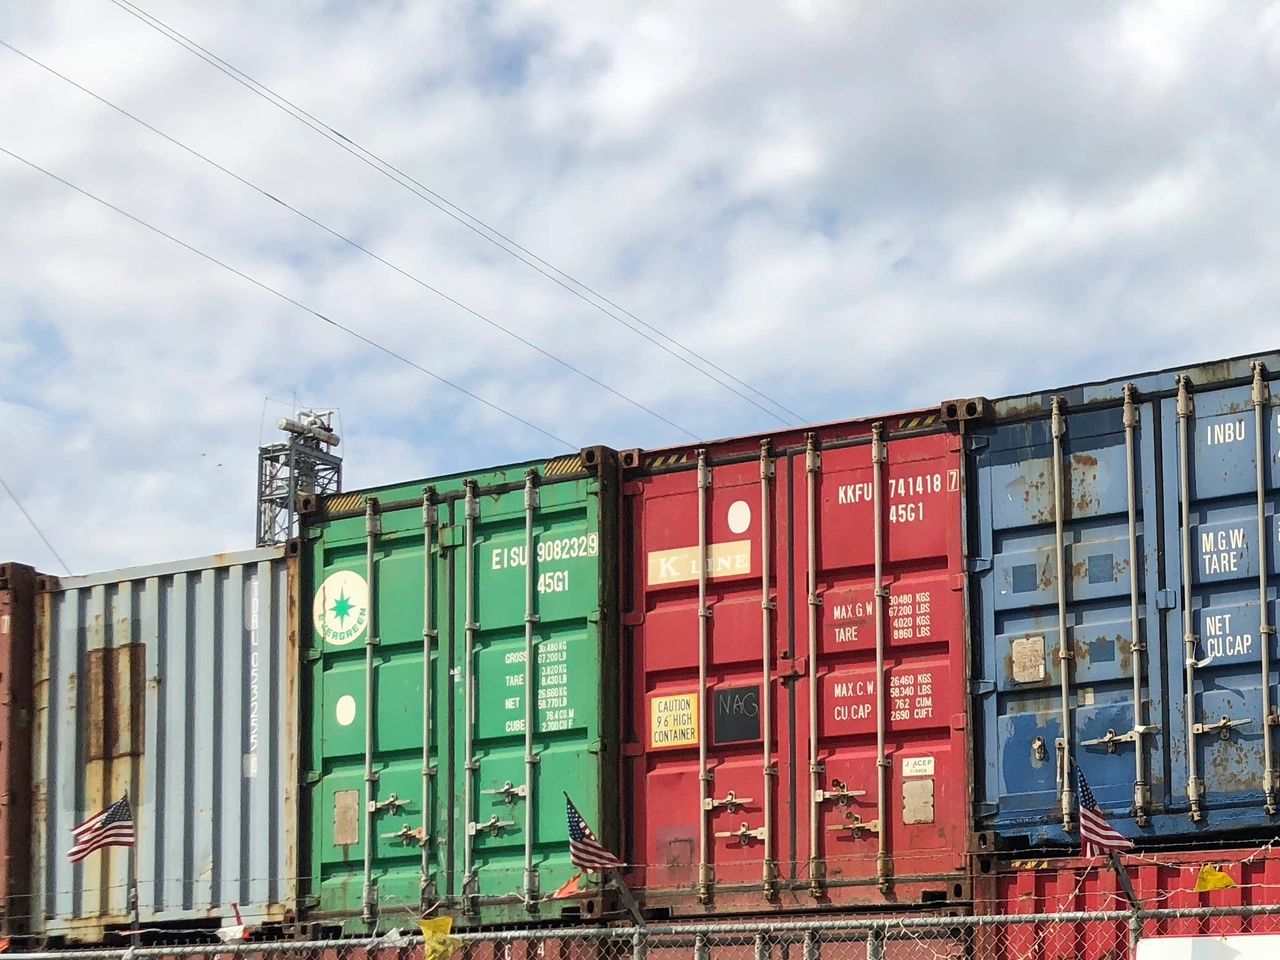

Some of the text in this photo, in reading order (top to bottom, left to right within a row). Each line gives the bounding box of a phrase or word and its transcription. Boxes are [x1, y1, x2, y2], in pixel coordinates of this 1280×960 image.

[1207, 421, 1245, 445] INBU
[839, 470, 958, 504] KKFU 741418 7
[890, 502, 923, 523] 45G1
[492, 545, 528, 569] EISU
[1203, 552, 1238, 574] TARE
[537, 570, 568, 593] 45G1
[1206, 614, 1231, 636] NET
[835, 626, 858, 643] TARE
[505, 651, 528, 664] GROSS
[559, 651, 567, 661] LB
[505, 674, 524, 687] TARE
[559, 674, 567, 684] LB
[505, 697, 520, 709] NET
[559, 697, 567, 707] LB
[658, 699, 691, 713] CAUTION
[505, 720, 525, 732] CUBE
[673, 713, 692, 726] HIGH
[654, 728, 695, 743] CONTAINER
